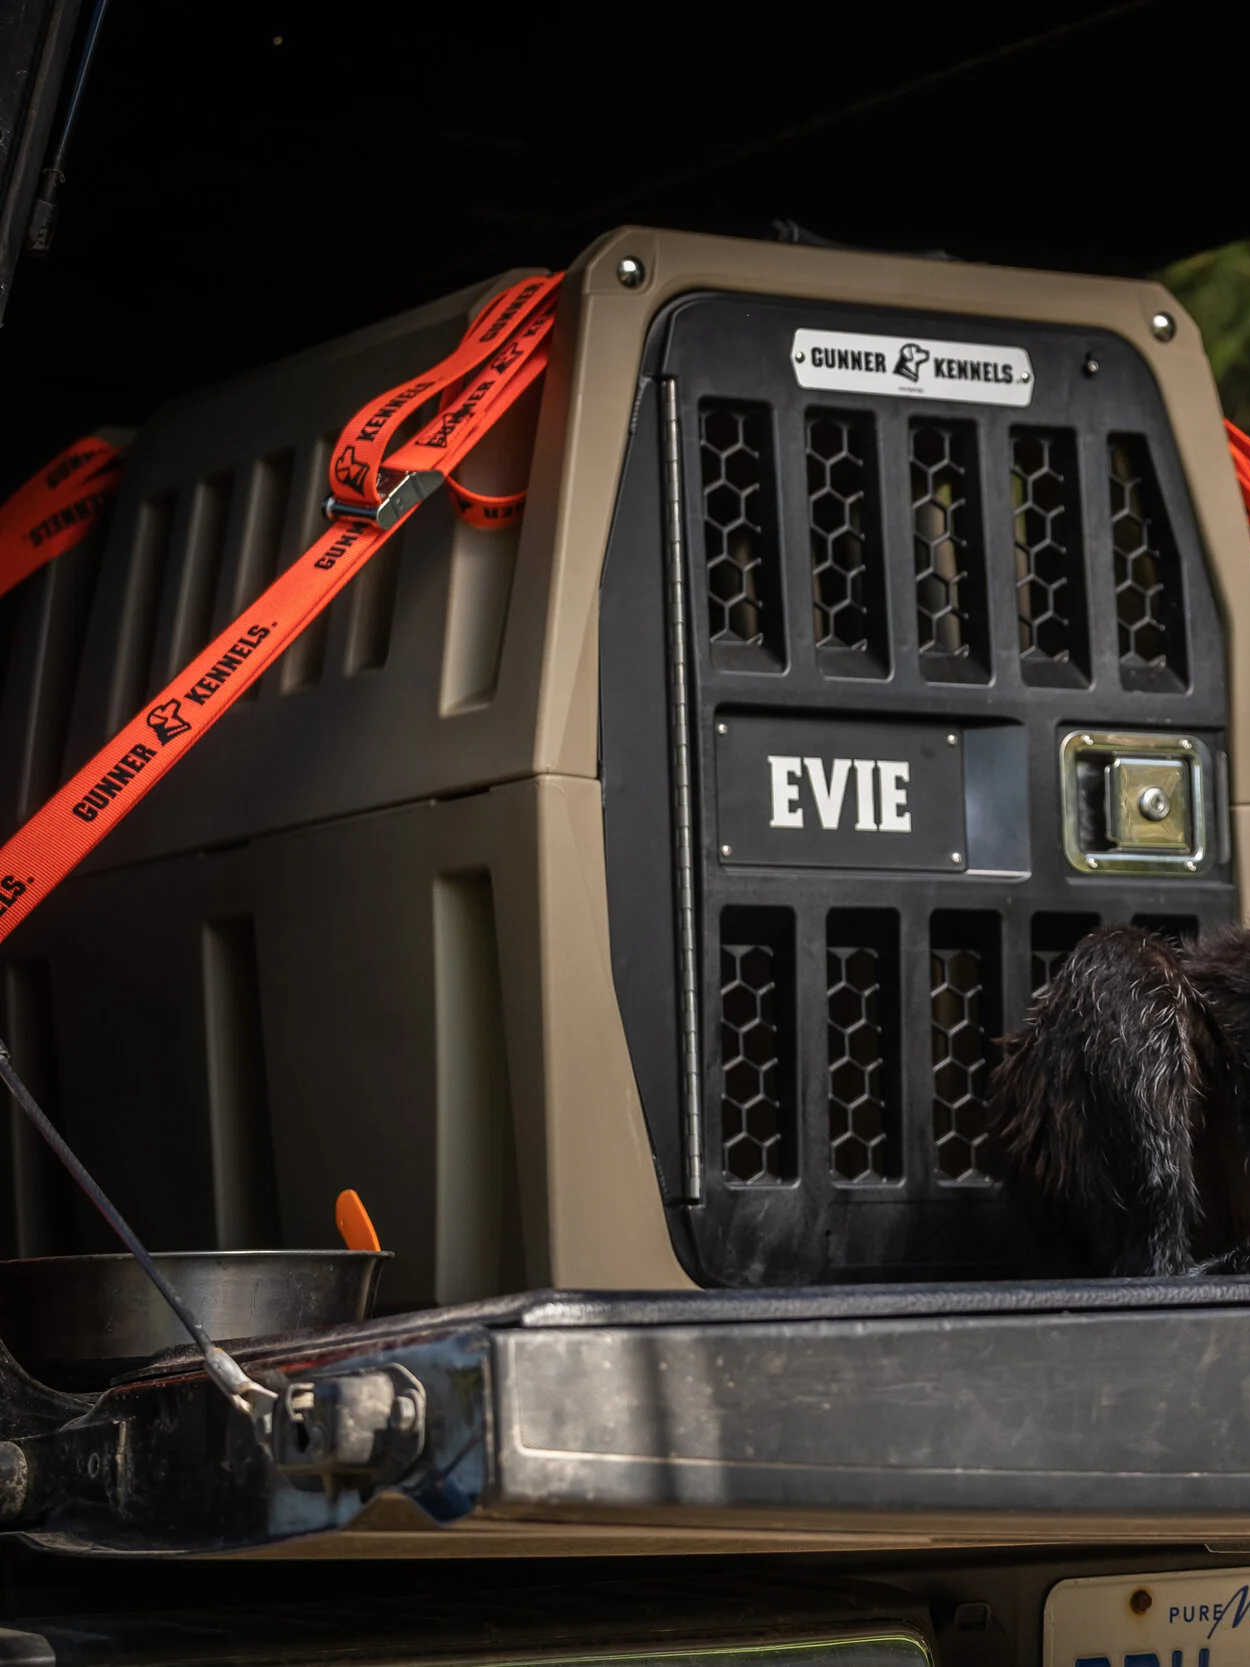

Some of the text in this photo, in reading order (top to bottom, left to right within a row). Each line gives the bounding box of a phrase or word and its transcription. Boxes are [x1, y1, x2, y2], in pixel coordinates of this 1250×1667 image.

[811, 347, 887, 374] GUNNER
[72, 743, 157, 823] GUNNER
[767, 755, 912, 833] EVIE
[1168, 1604, 1224, 1623] PURE
